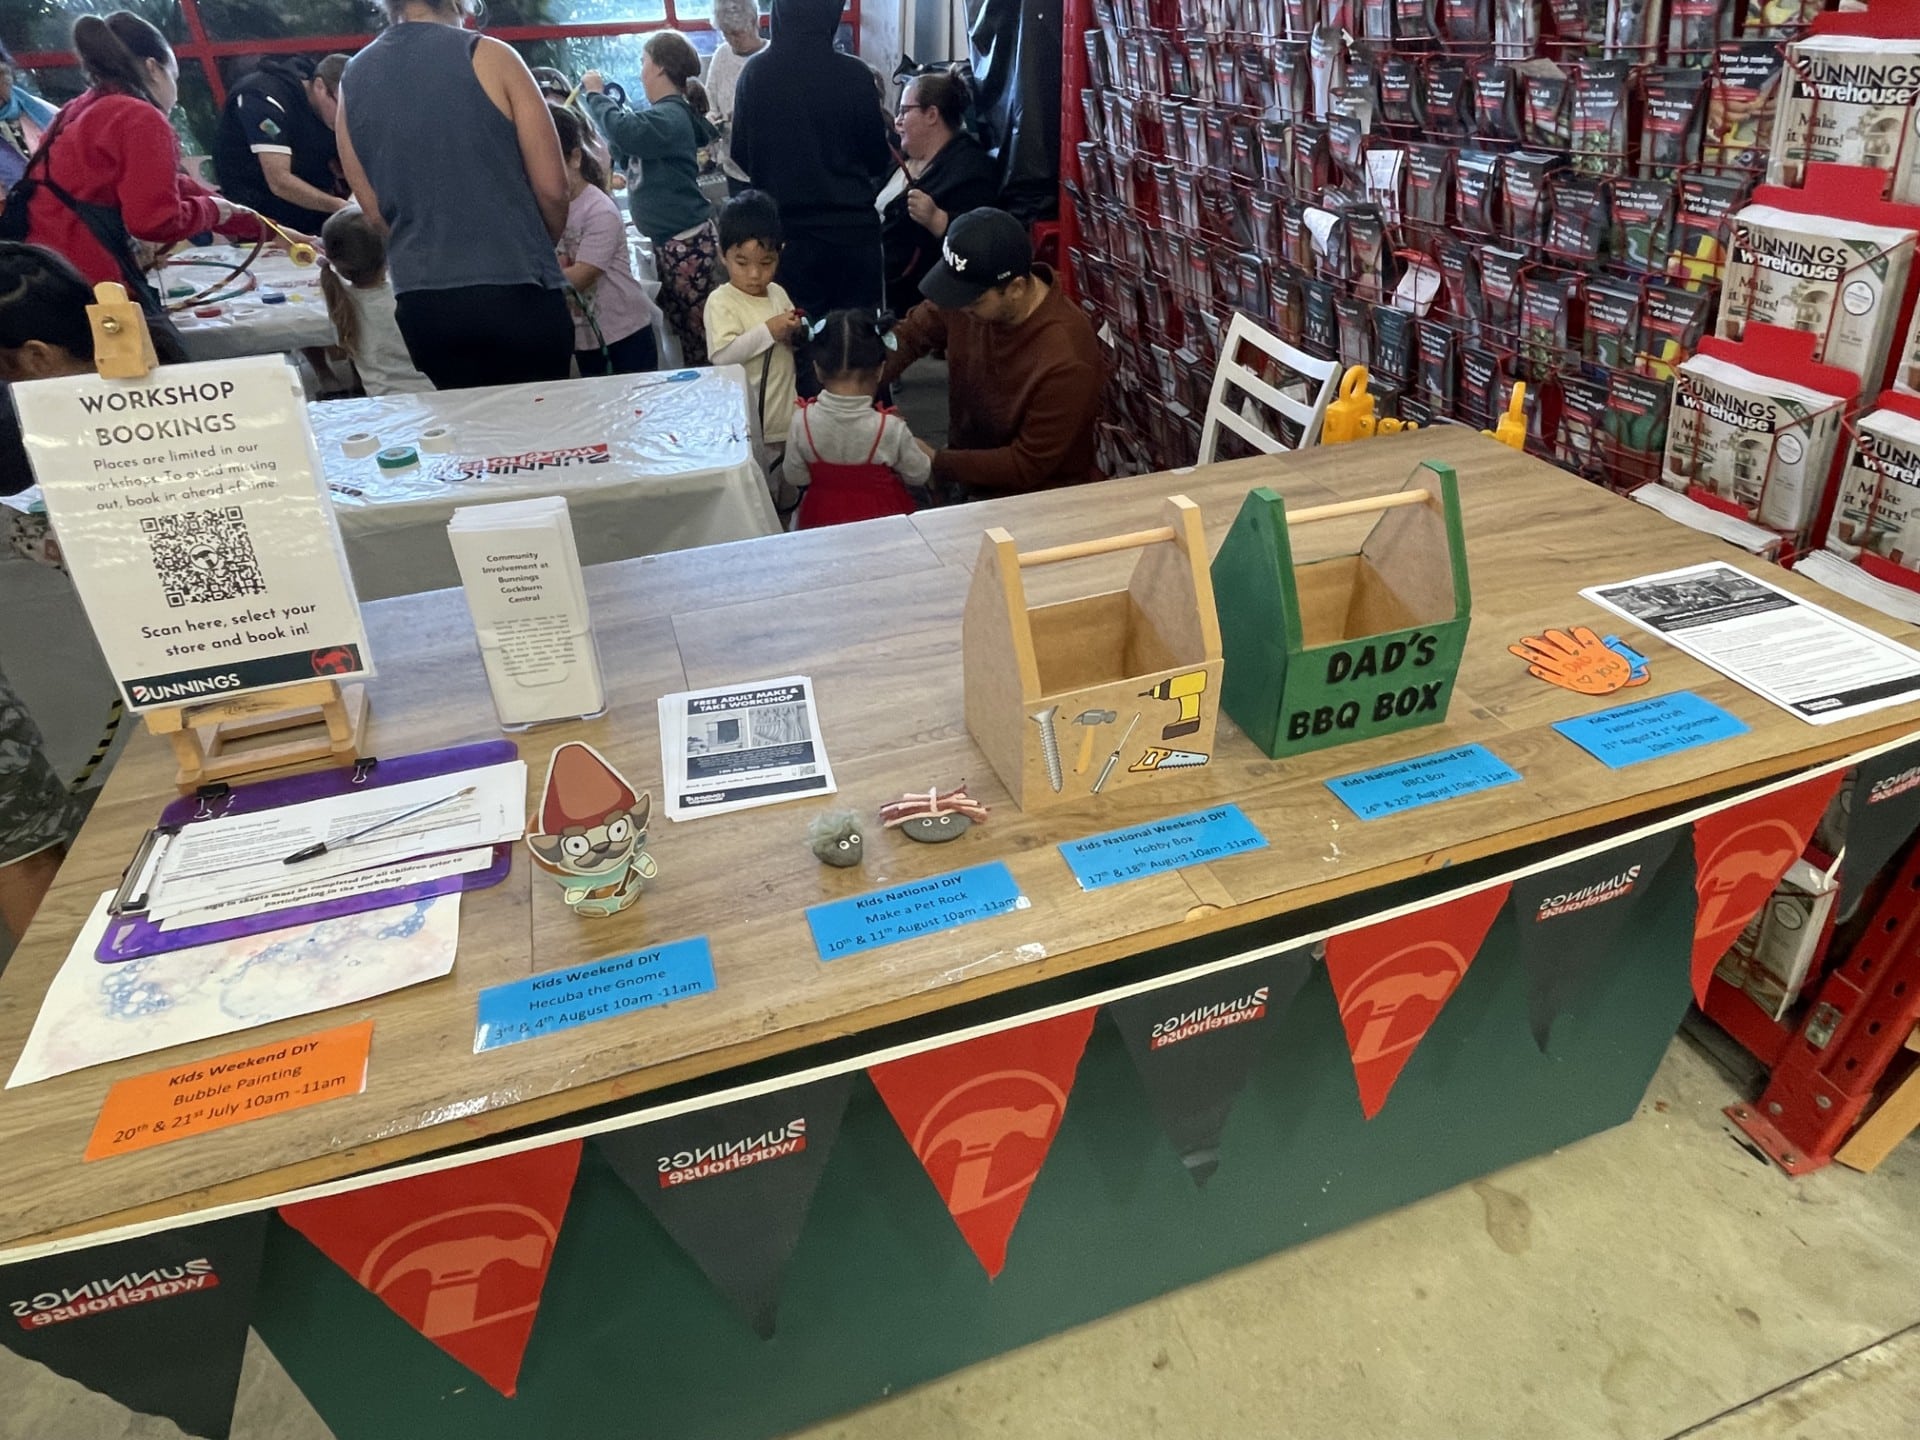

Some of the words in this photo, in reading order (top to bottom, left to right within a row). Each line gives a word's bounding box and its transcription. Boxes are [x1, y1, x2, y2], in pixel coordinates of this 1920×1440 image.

[1801, 82, 1911, 105] warehouse
[1736, 225, 1848, 266] BUNNINGS
[1741, 249, 1839, 281] warehouse
[79, 381, 235, 415] WORKSHOP
[96, 413, 237, 446] BOOKINGS
[93, 456, 138, 472] Places
[142, 455, 165, 466] are
[169, 446, 217, 463] limited
[220, 444, 233, 455] in
[237, 443, 258, 453] our
[97, 500, 123, 512] out,
[126, 493, 161, 508] book
[164, 491, 177, 501] in
[182, 482, 225, 500] ahead
[482, 562, 538, 574] Involvement
[486, 552, 539, 564] Community
[498, 574, 540, 584] Bunnings
[500, 584, 543, 594] Cockburn
[508, 594, 541, 604] Central
[141, 625, 182, 641] Scan
[186, 616, 229, 632] here,
[231, 608, 278, 625] select
[281, 603, 317, 620] your
[165, 642, 206, 658] store
[211, 633, 243, 650] and
[247, 627, 287, 644] book
[290, 622, 311, 638] in!
[1326, 632, 1439, 685] DAD'S
[132, 672, 241, 703] BUNNINGS
[693, 698, 717, 707] FREE
[721, 693, 753, 704] ADULT
[756, 688, 787, 699] MAKE
[700, 702, 727, 712] TAKE
[729, 694, 794, 710] WORKSHOP
[1287, 700, 1361, 741] BBQ
[1372, 680, 1443, 723] BOX
[1341, 776, 1365, 788] Kids
[1366, 764, 1408, 783] National
[1409, 754, 1457, 773] Weekend
[1402, 776, 1426, 788] BBQ
[1427, 772, 1447, 783] Box
[1416, 785, 1451, 801] August
[1076, 841, 1101, 852] Kids
[1103, 828, 1152, 847] National
[1153, 815, 1207, 835] Weekend
[1208, 810, 1228, 822] DIY
[1133, 841, 1170, 857] Hobby
[1172, 835, 1195, 846] Box
[1088, 872, 1109, 884] 17th
[1113, 868, 1123, 879] &
[1125, 861, 1147, 875] 18th
[1150, 852, 1190, 870] August
[1190, 845, 1223, 860] 10am
[856, 897, 883, 910] Kids
[886, 881, 939, 902] National
[941, 875, 962, 888] DIY
[865, 909, 901, 925] Make
[904, 906, 912, 914] a
[914, 899, 936, 913] Pet
[939, 891, 969, 905] Rock
[828, 937, 852, 953] 10th
[856, 934, 867, 945] &
[871, 926, 892, 942] 11th
[897, 916, 940, 936] August
[942, 907, 977, 924] 10am
[531, 976, 563, 991] Kids
[566, 958, 634, 984] Weekend
[638, 951, 662, 967] DIY
[529, 990, 584, 1011] Hecuba
[588, 984, 612, 997] the
[614, 969, 667, 991] Gnome
[494, 1024, 514, 1041] 3rd
[518, 1021, 531, 1034] &
[535, 1014, 555, 1030] 4th
[559, 1002, 609, 1025] August
[614, 992, 653, 1011] 10am
[168, 1070, 204, 1087] Kids
[209, 1049, 287, 1077] Weekend
[291, 1041, 320, 1056] DIY
[173, 1082, 232, 1107] Bubble
[236, 1066, 304, 1090] Painting
[112, 1123, 149, 1144] 20th
[152, 1119, 166, 1133] &
[171, 1109, 204, 1129] 21st
[206, 1101, 240, 1120] July
[244, 1091, 290, 1110] 10am
